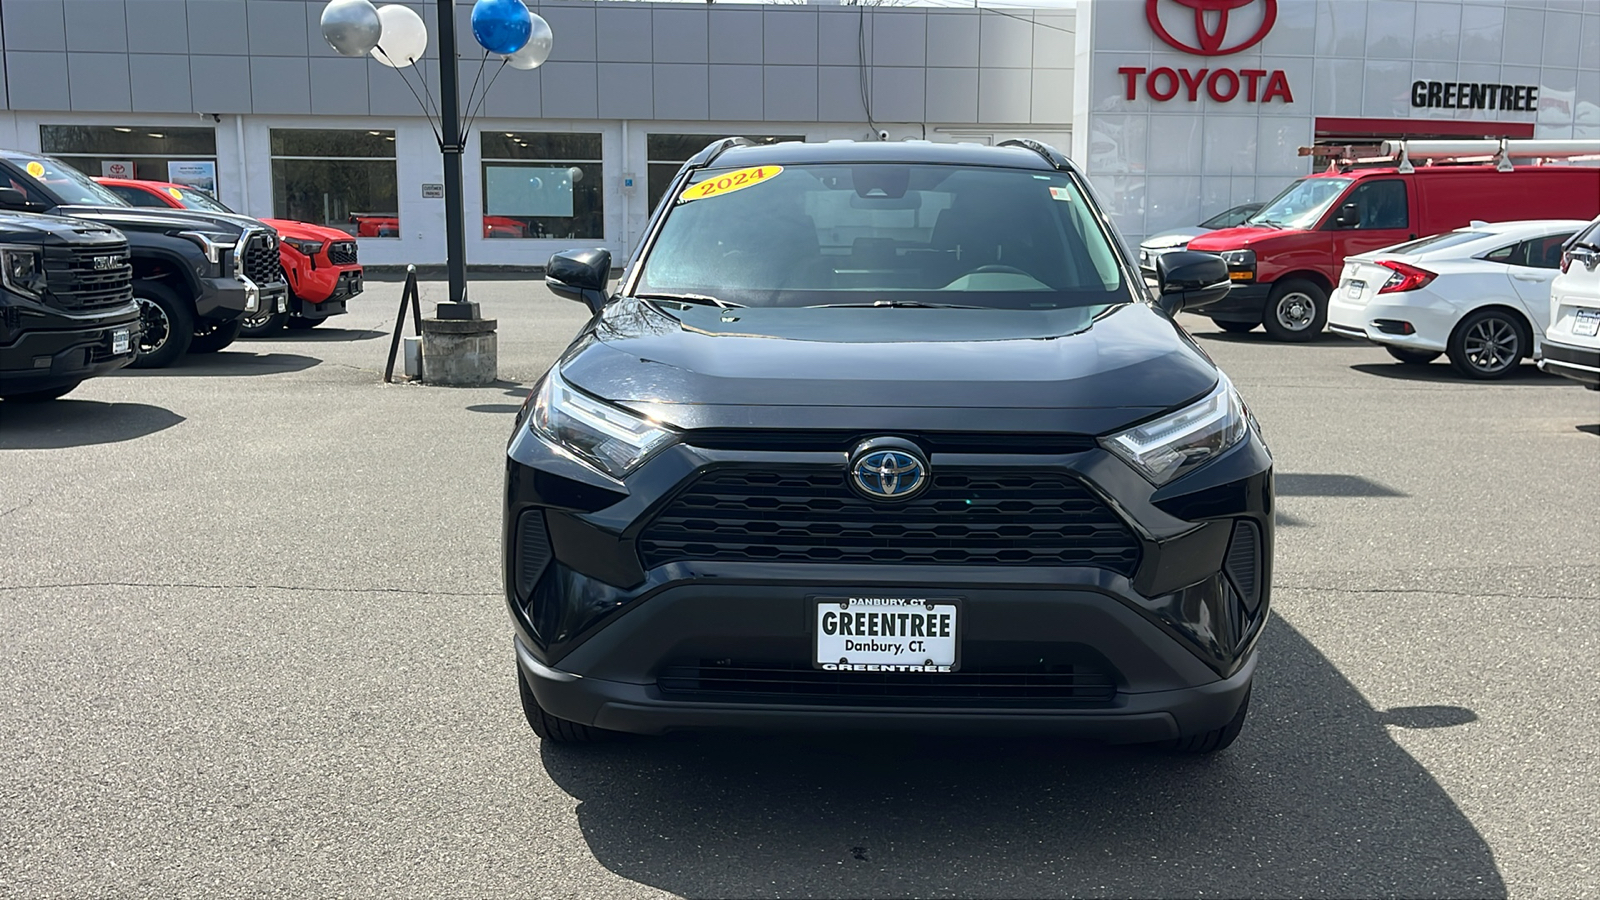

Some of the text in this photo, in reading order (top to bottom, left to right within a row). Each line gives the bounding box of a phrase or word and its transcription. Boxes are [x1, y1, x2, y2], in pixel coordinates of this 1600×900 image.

[1118, 66, 1294, 103] TOYOTA
[1411, 80, 1538, 112] GREENTREE
[701, 168, 766, 197] 2024
[93, 255, 123, 270] GMC
[848, 598, 907, 606] DANBURY,
[822, 611, 950, 637] GREENTREE
[845, 639, 926, 655] Danbury, CT.
[822, 664, 951, 673] GREENTREE
